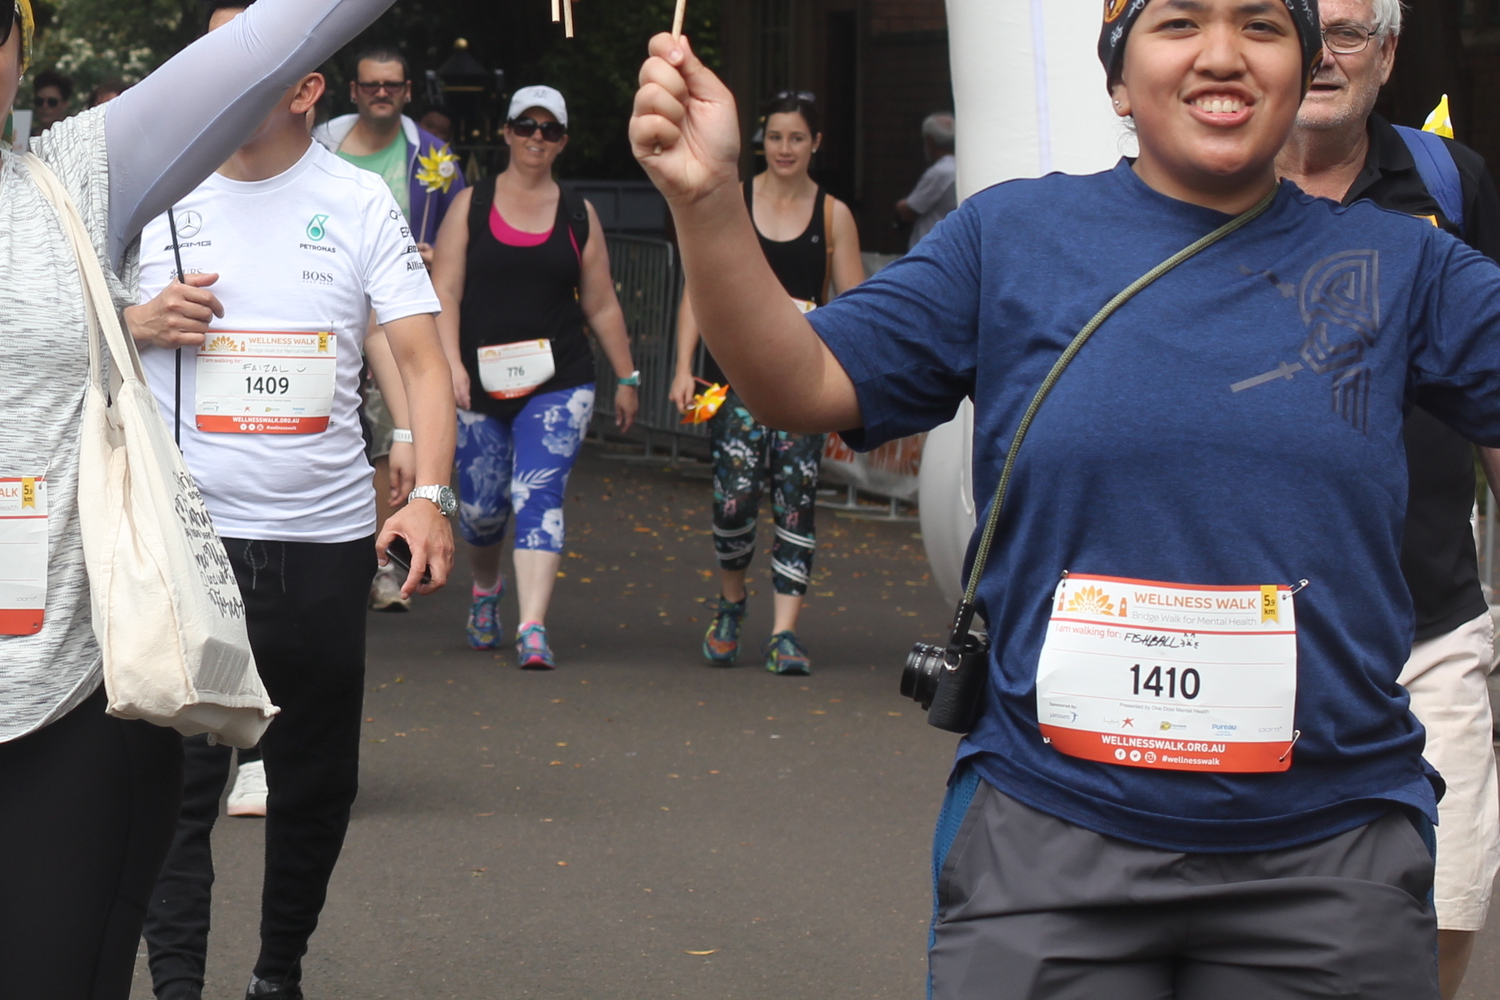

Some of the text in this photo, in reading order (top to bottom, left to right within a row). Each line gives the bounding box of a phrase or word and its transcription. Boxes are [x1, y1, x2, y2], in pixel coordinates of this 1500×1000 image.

[179, 240, 212, 249] AMG
[299, 243, 336, 253] PETRONAS
[302, 270, 334, 282] BOSS
[248, 337, 292, 345] WELLNESS
[242, 363, 289, 373] FAIZAL
[507, 366, 525, 378] 776
[245, 376, 289, 395] 1409
[232, 416, 300, 424] WELLNESSWALK.ORG.AU
[1134, 591, 1257, 610] WELLNESS WALK
[1132, 611, 1257, 626] Bridge Walk for Mental Health
[1059, 625, 1071, 633] am
[1072, 625, 1105, 638] walking
[1106, 629, 1122, 639] for:
[1130, 663, 1201, 700] 1410
[1119, 702, 1143, 710] Presented
[1101, 734, 1226, 754] WELLNESSWALK.ORG.AU
[1161, 754, 1221, 766] #wellnesswalk
